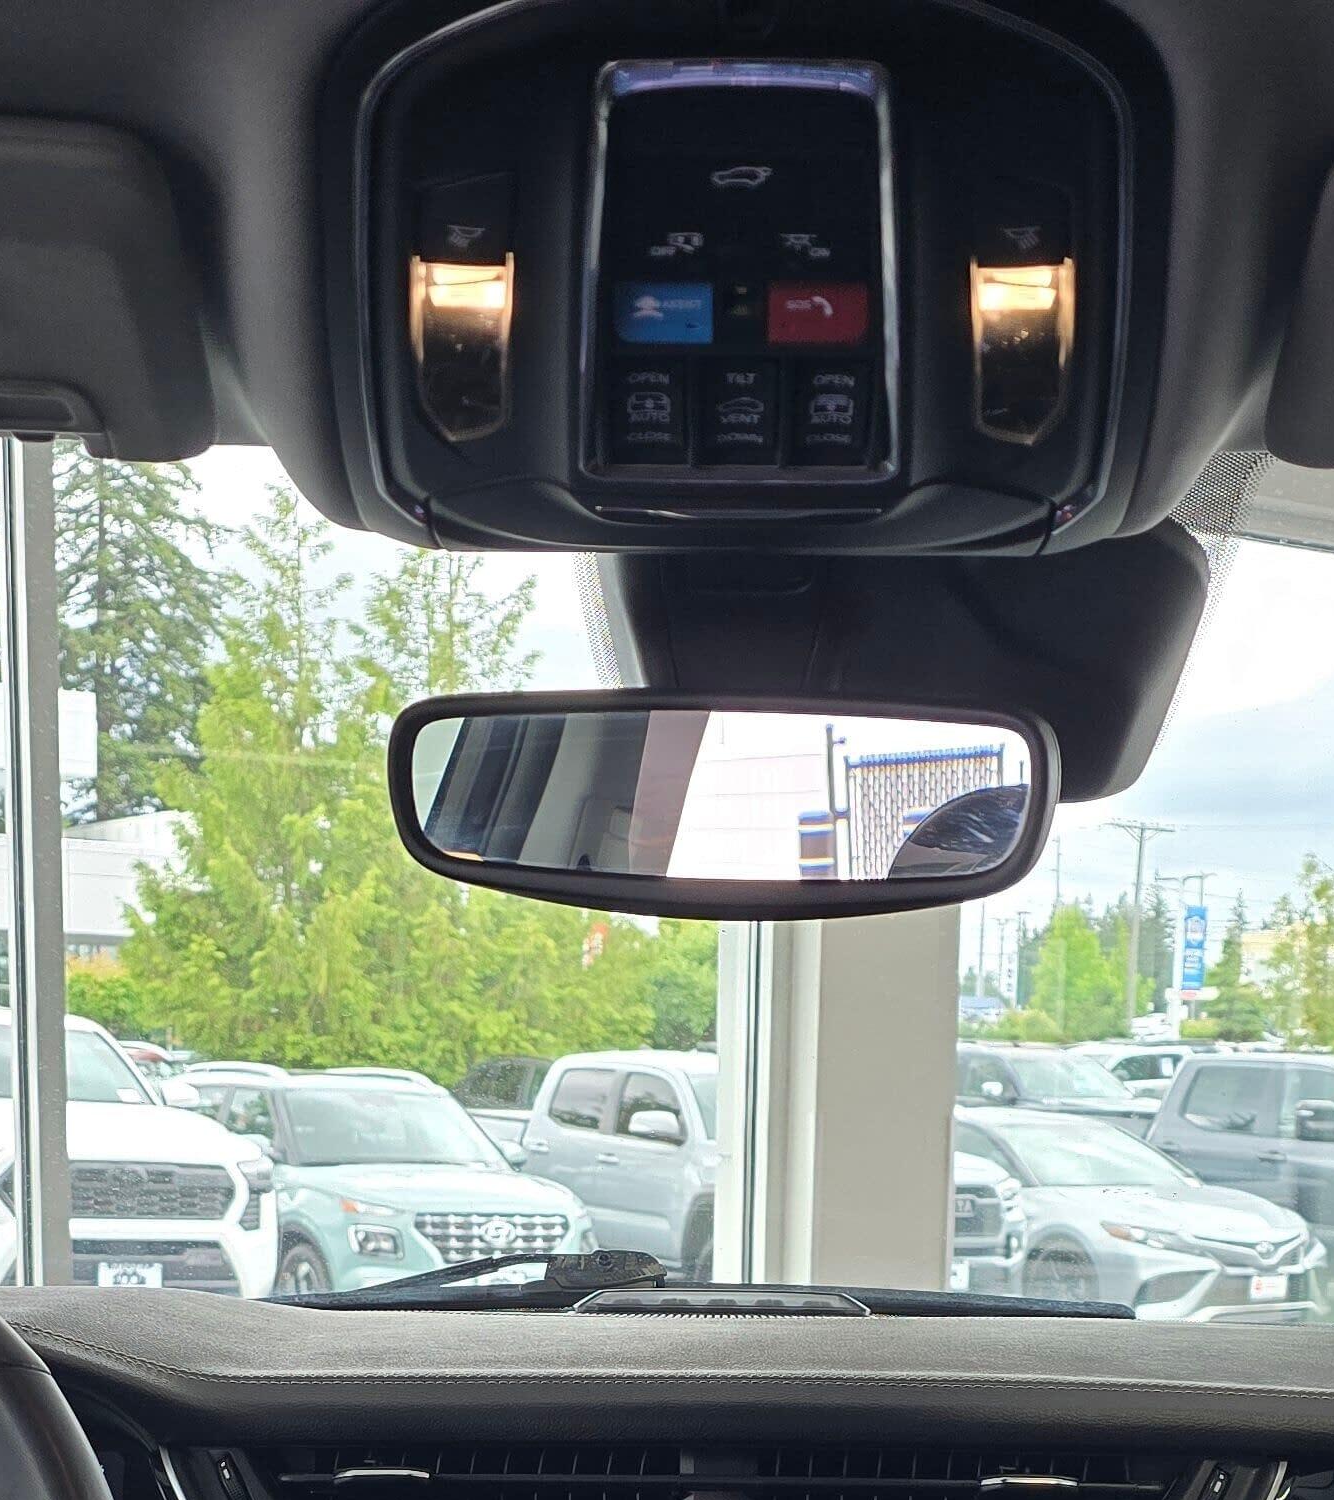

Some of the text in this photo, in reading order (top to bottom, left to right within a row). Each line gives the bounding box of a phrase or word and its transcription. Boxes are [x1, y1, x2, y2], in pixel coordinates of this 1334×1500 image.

[628, 373, 670, 384] OPEN
[726, 372, 756, 384] TILT
[813, 375, 855, 387] OPEN
